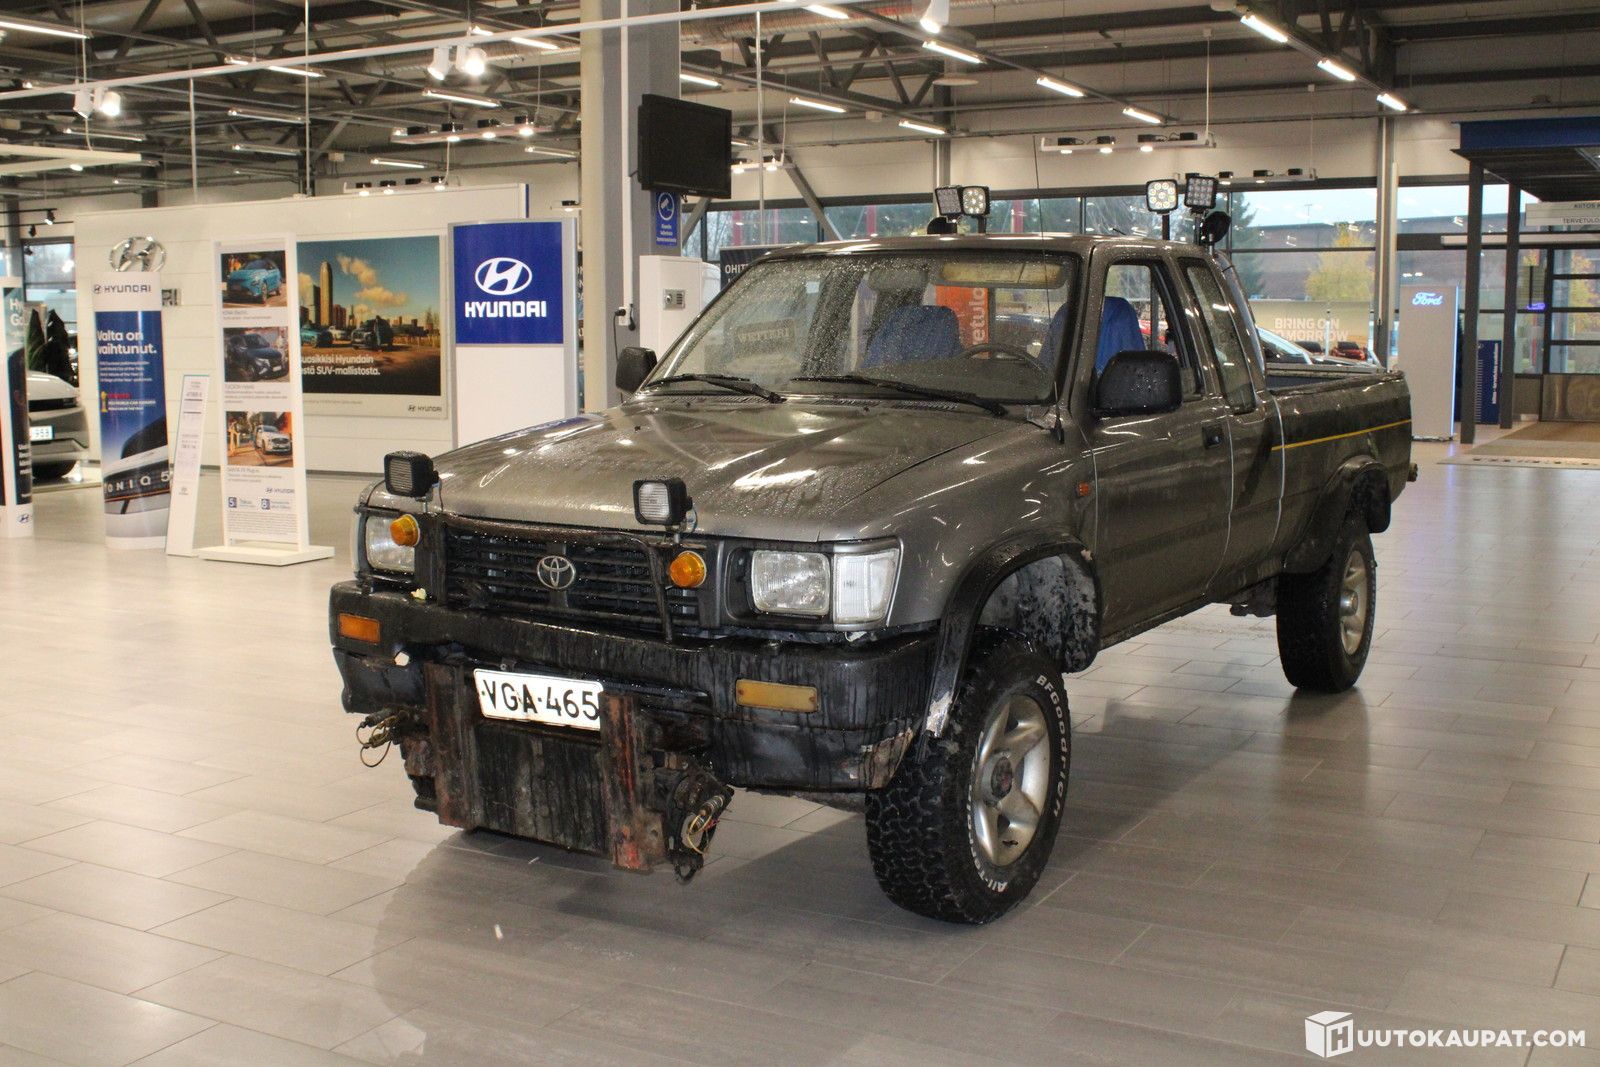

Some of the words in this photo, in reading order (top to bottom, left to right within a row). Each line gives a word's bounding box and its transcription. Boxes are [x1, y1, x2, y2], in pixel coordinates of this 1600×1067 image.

[104, 284, 151, 293] HYUNDAI
[1412, 291, 1443, 305] Ford
[465, 300, 547, 318] HYUNDAI
[1274, 317, 1315, 330] BRING
[125, 331, 144, 341] on
[335, 354, 374, 366] Hyundain
[317, 366, 381, 376] SUV-mallistosta.
